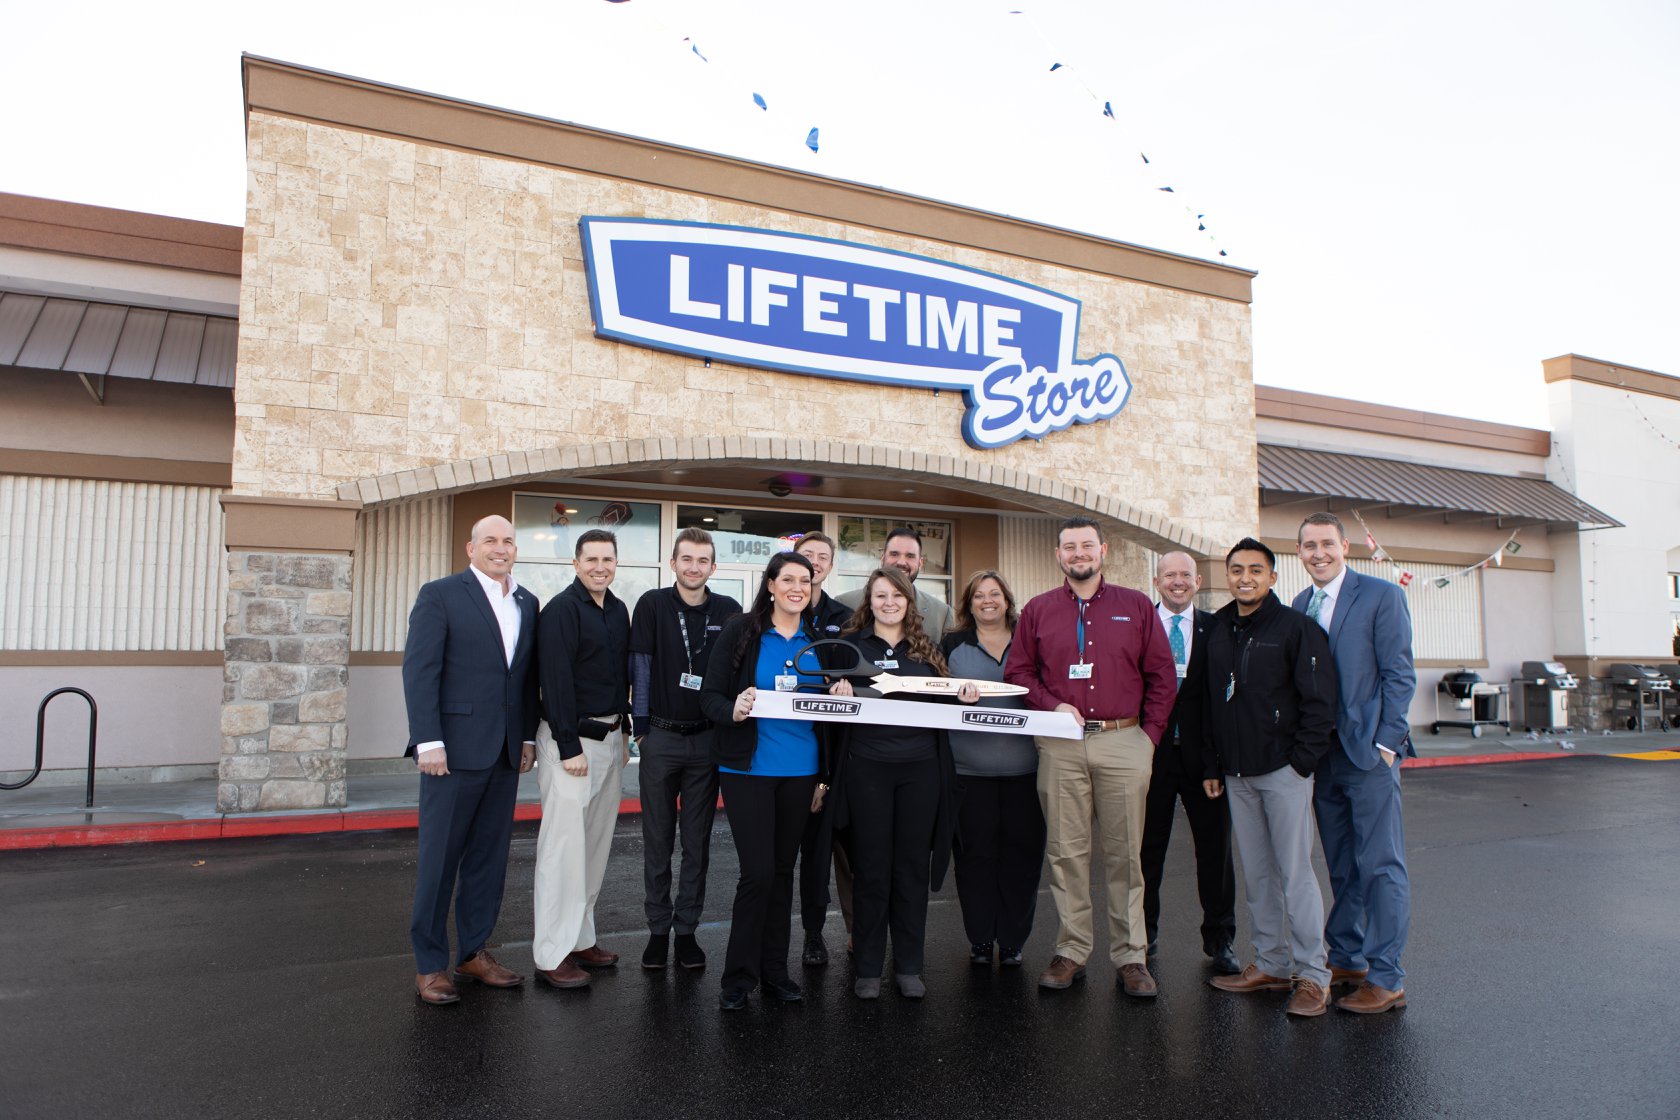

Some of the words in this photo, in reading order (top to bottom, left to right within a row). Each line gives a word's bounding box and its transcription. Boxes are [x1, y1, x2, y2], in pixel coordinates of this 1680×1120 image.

[669, 254, 1022, 358] LIFETIME
[981, 363, 1116, 431] Store
[731, 539, 770, 556] 10495
[800, 701, 853, 712] LIFETIME
[969, 713, 1020, 725] LIFETIME
